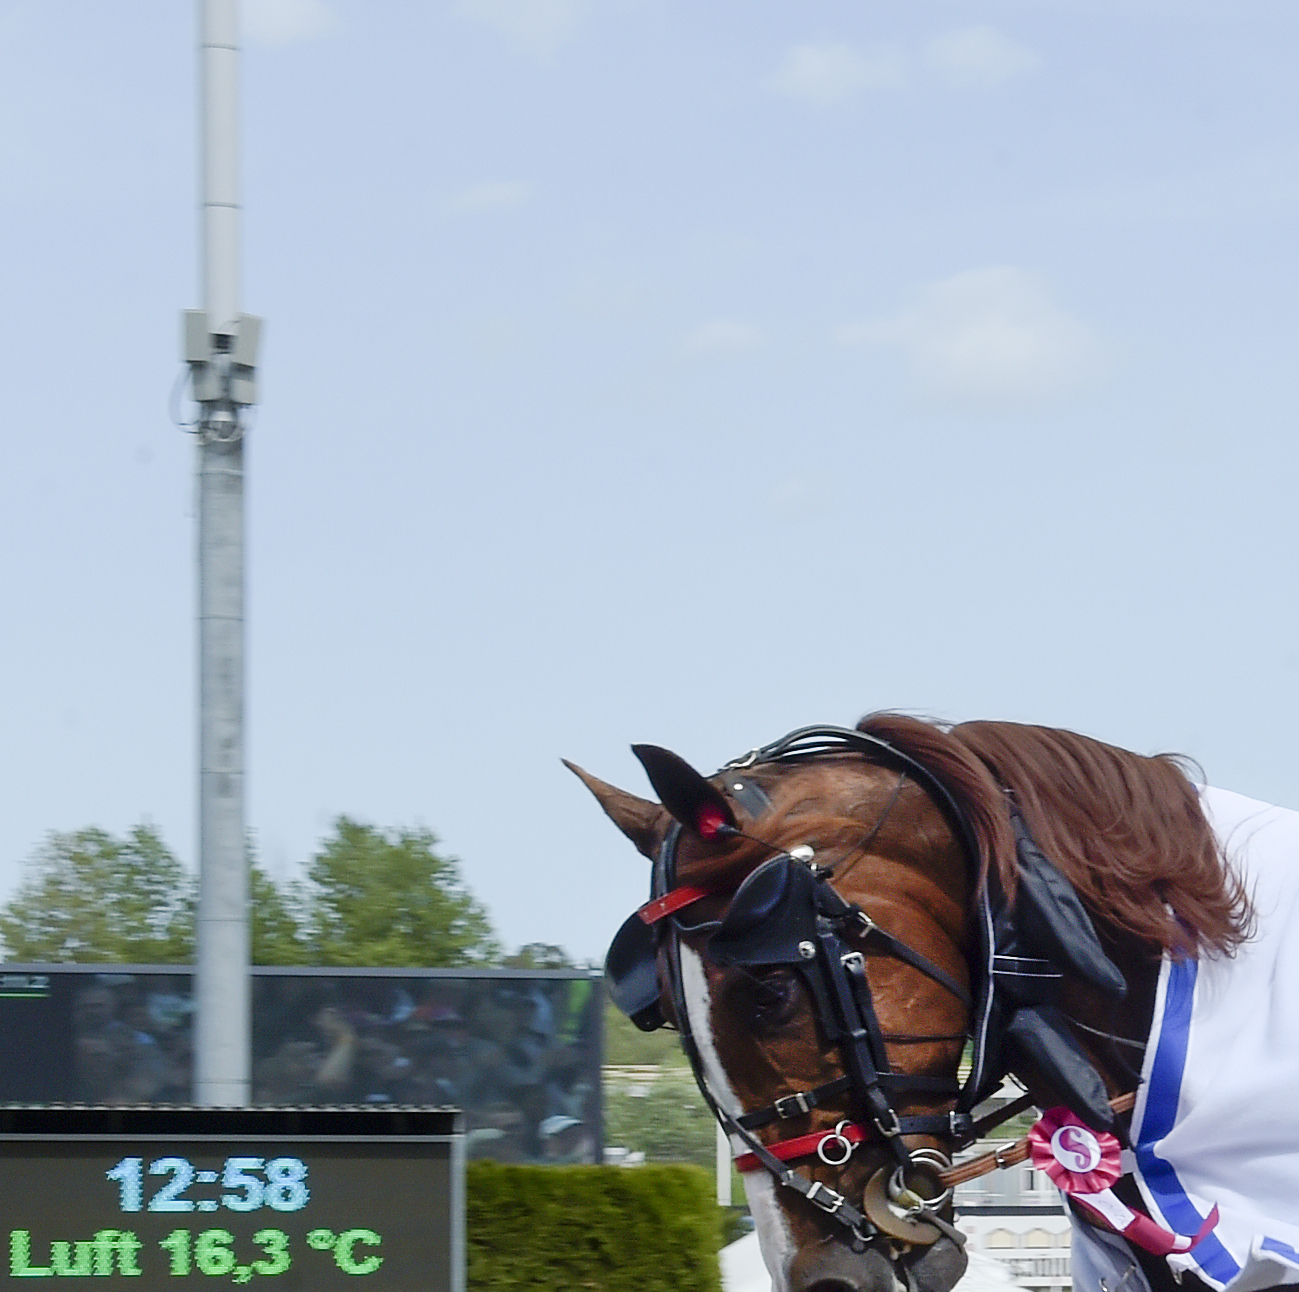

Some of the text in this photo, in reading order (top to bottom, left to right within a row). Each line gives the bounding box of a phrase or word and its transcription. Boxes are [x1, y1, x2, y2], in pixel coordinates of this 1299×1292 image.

[105, 1157, 311, 1213] 12:58
[10, 1229, 385, 1285] Luft 16,3 °C
